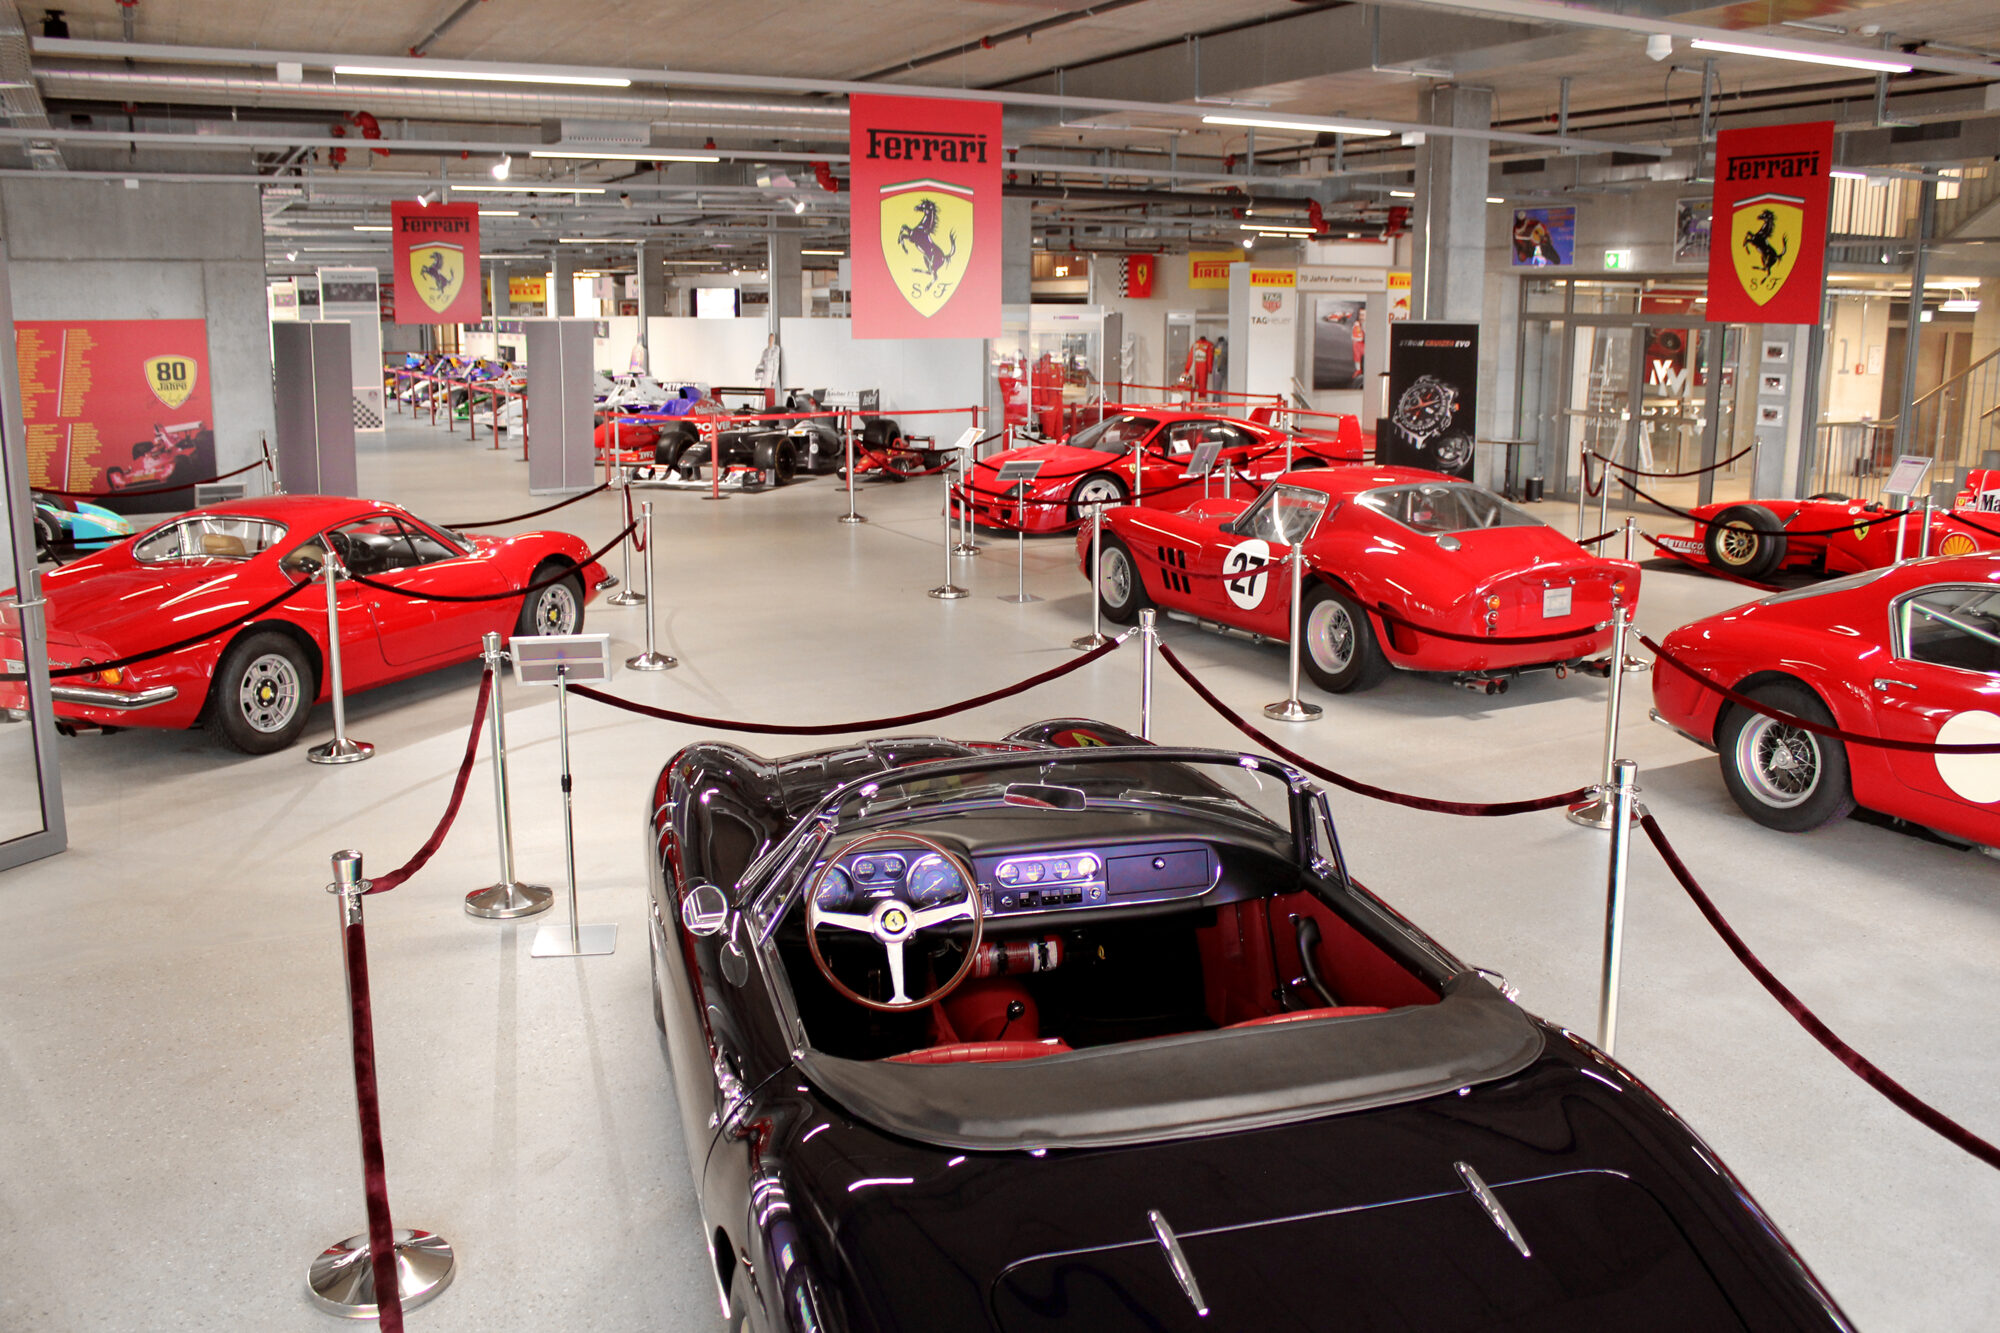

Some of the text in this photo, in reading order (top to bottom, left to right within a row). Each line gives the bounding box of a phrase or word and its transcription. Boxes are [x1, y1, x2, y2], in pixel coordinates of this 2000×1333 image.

[866, 128, 987, 163] Ferrari
[1726, 151, 1820, 181] Ferrari
[401, 216, 470, 232] Ferrari
[1193, 260, 1239, 278] PIREL
[1252, 273, 1293, 284] PIRELLI
[911, 283, 921, 299] S
[1454, 340, 1471, 348] EVO
[157, 362, 186, 381] 80
[157, 382, 187, 391] Jahre
[1673, 540, 1704, 550] TELECO
[1230, 552, 1266, 597] 27
